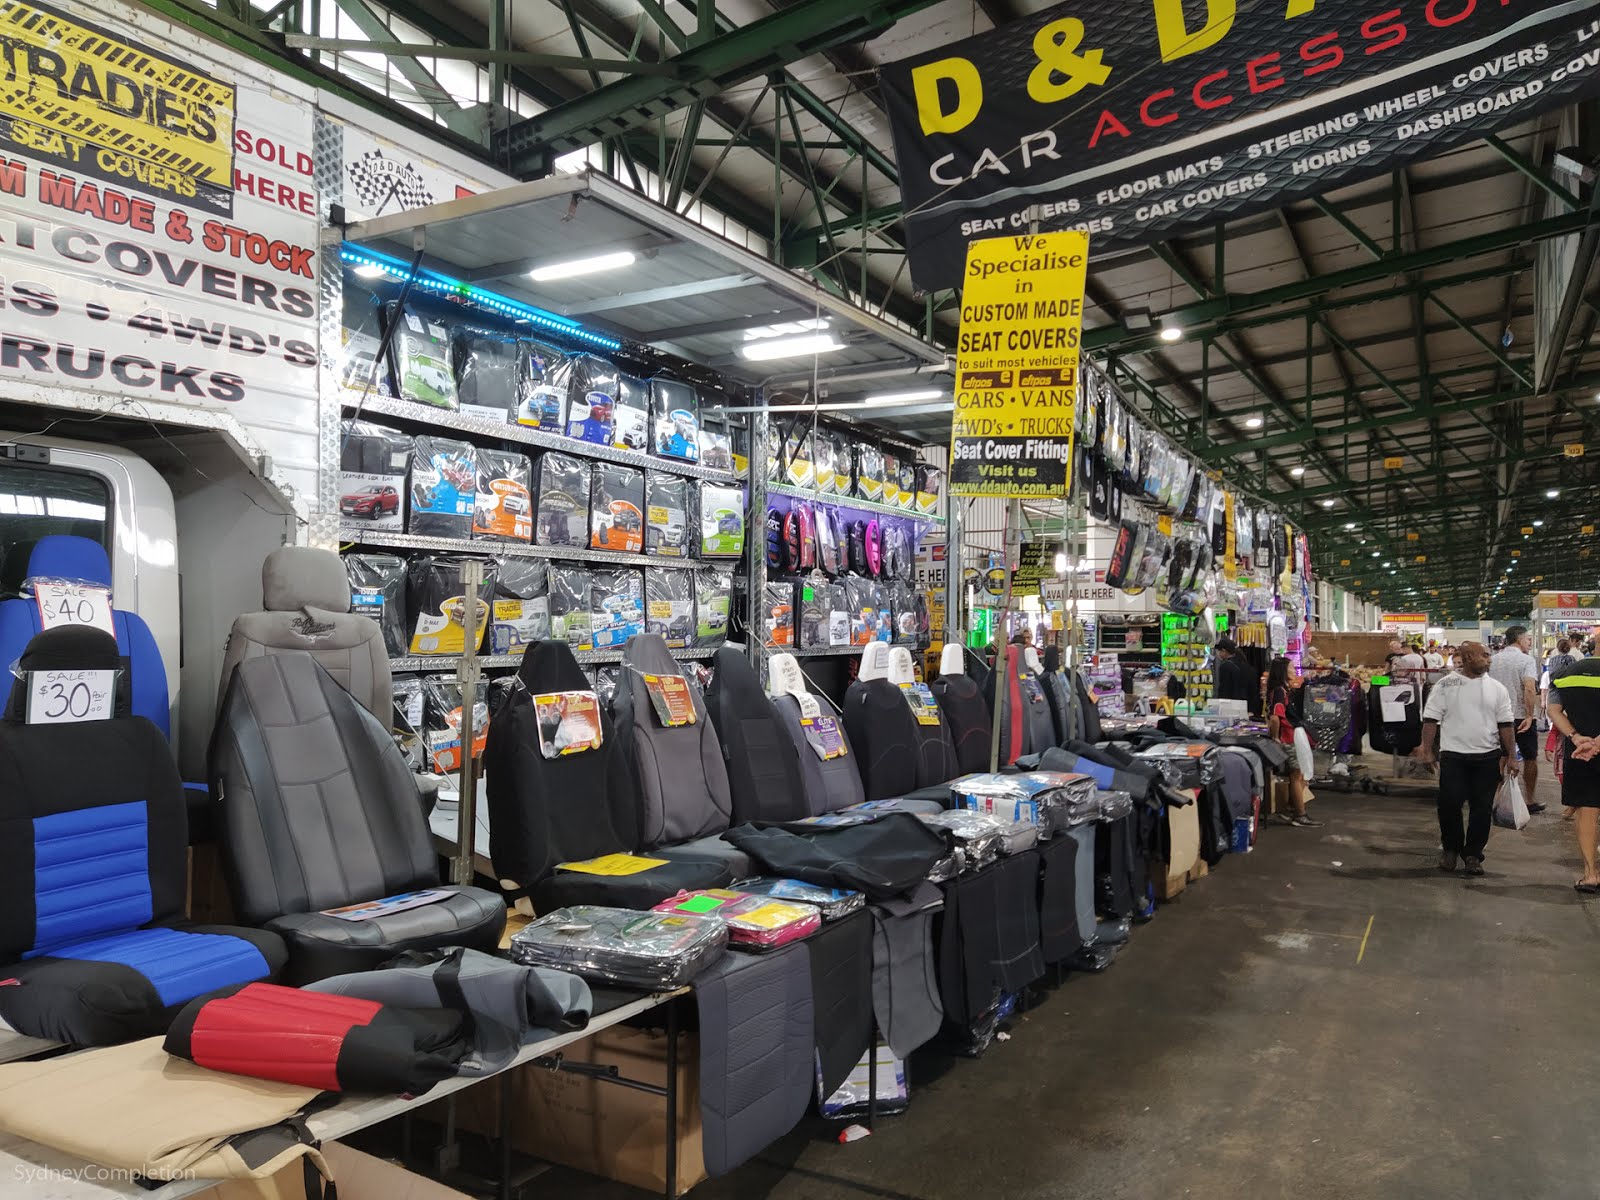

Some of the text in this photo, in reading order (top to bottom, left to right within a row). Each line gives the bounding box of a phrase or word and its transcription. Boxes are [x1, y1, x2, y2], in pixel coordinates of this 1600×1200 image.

[911, 0, 1236, 136] D & D
[929, 0, 1510, 186] CAR ACCESSO
[960, 217, 1005, 236] SEAT
[1096, 176, 1162, 205] FLOOR
[1167, 156, 1224, 185] MATS
[1247, 112, 1359, 159] STEERING
[1363, 86, 1447, 121] WHEEL
[1452, 43, 1549, 89] COVERS
[1135, 200, 1177, 222] CAR
[1182, 172, 1268, 209] COVERS
[1292, 140, 1371, 176] HORNS
[1397, 79, 1544, 141] DASHBOARD
[10, 119, 197, 197] SEAT COVERS
[235, 129, 314, 177] SOLD
[387, 161, 394, 172] D
[395, 165, 416, 189] AUTO
[235, 170, 316, 216] HERE
[38, 168, 156, 234] MADE
[165, 208, 193, 244] &
[202, 219, 315, 279] STOCK
[1014, 236, 1047, 252] We
[968, 252, 1083, 279] Specialise
[1015, 279, 1033, 293] in
[963, 299, 1080, 323] CUSTOM MADE
[960, 327, 1078, 353] SEAT COVERS
[0, 332, 246, 402] RUCKS
[959, 356, 1076, 369] to suit most vehicles
[963, 377, 993, 388] eftpos
[1020, 375, 1052, 386] eftpos
[957, 390, 1074, 409] CARS VANS
[954, 417, 1072, 435] 4WD's TRUCKS
[954, 440, 1069, 464] Seat Cover Fitting
[978, 465, 1038, 476] Visit us
[950, 480, 1065, 495] www.ddauto.com.au
[51, 587, 87, 597] SALE
[1092, 588, 1113, 598] HERE
[43, 598, 95, 623] $40
[39, 682, 91, 718] $30
